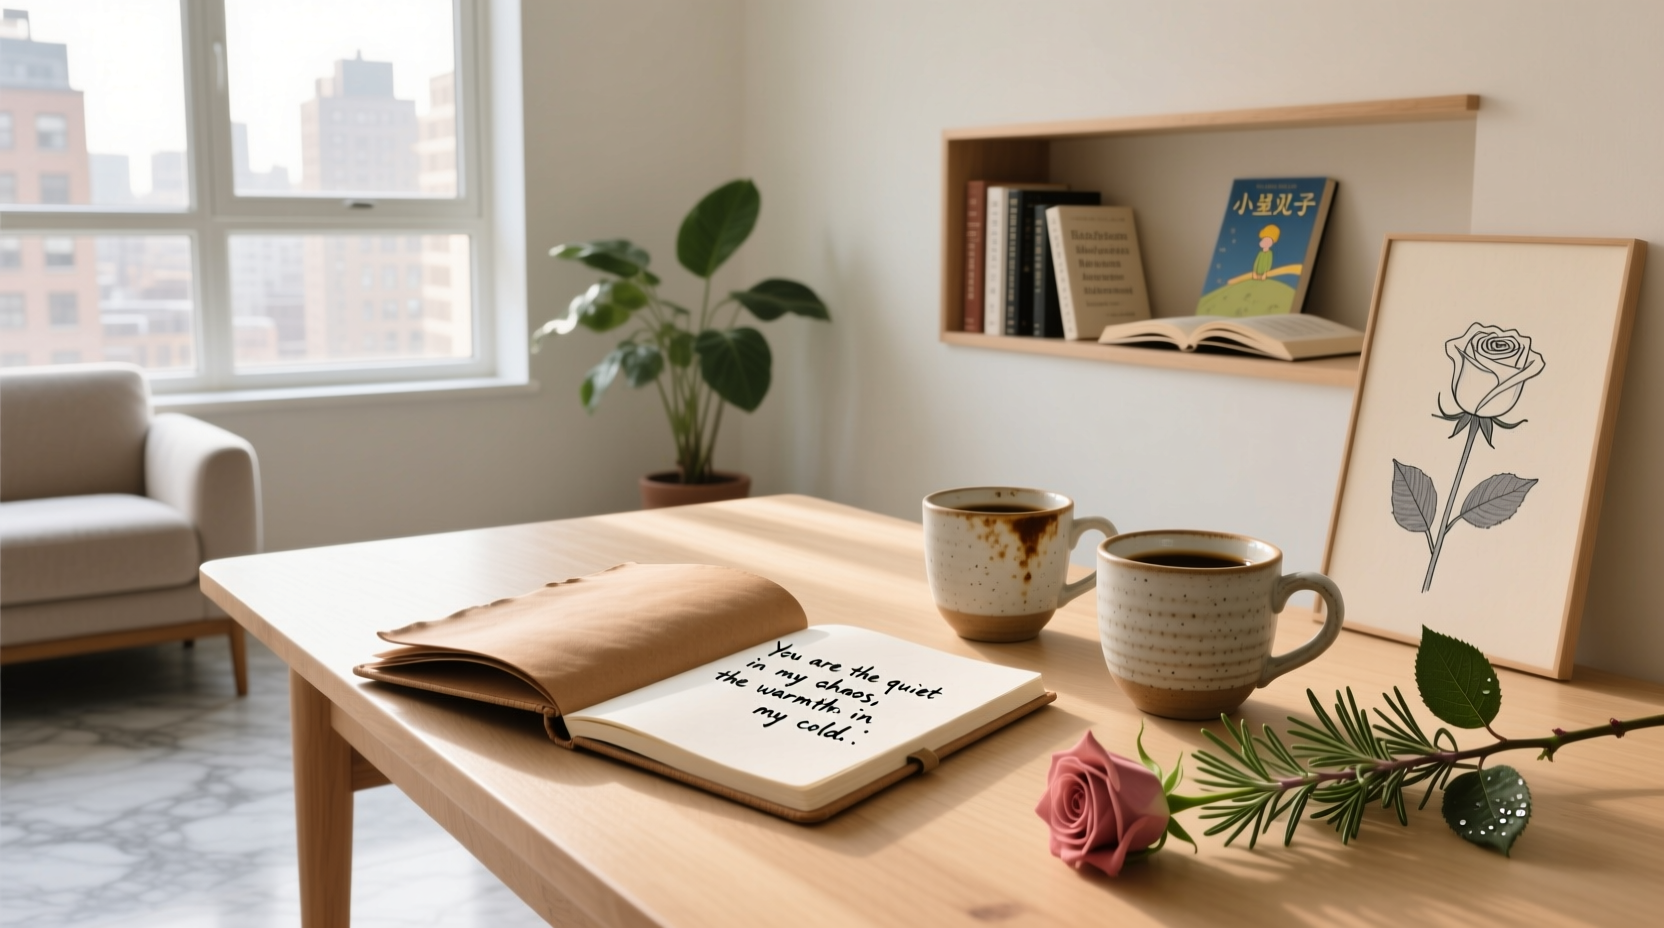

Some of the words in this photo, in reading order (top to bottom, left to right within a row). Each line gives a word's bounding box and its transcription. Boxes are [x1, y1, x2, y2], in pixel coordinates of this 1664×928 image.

[747, 658, 766, 671] in
[775, 669, 808, 688] my
[769, 641, 802, 661] You
[809, 658, 842, 672] are
[850, 666, 880, 682] the
[886, 681, 943, 700] quiet
[716, 671, 749, 688] the
[850, 708, 872, 724] in
[753, 707, 788, 727] my
